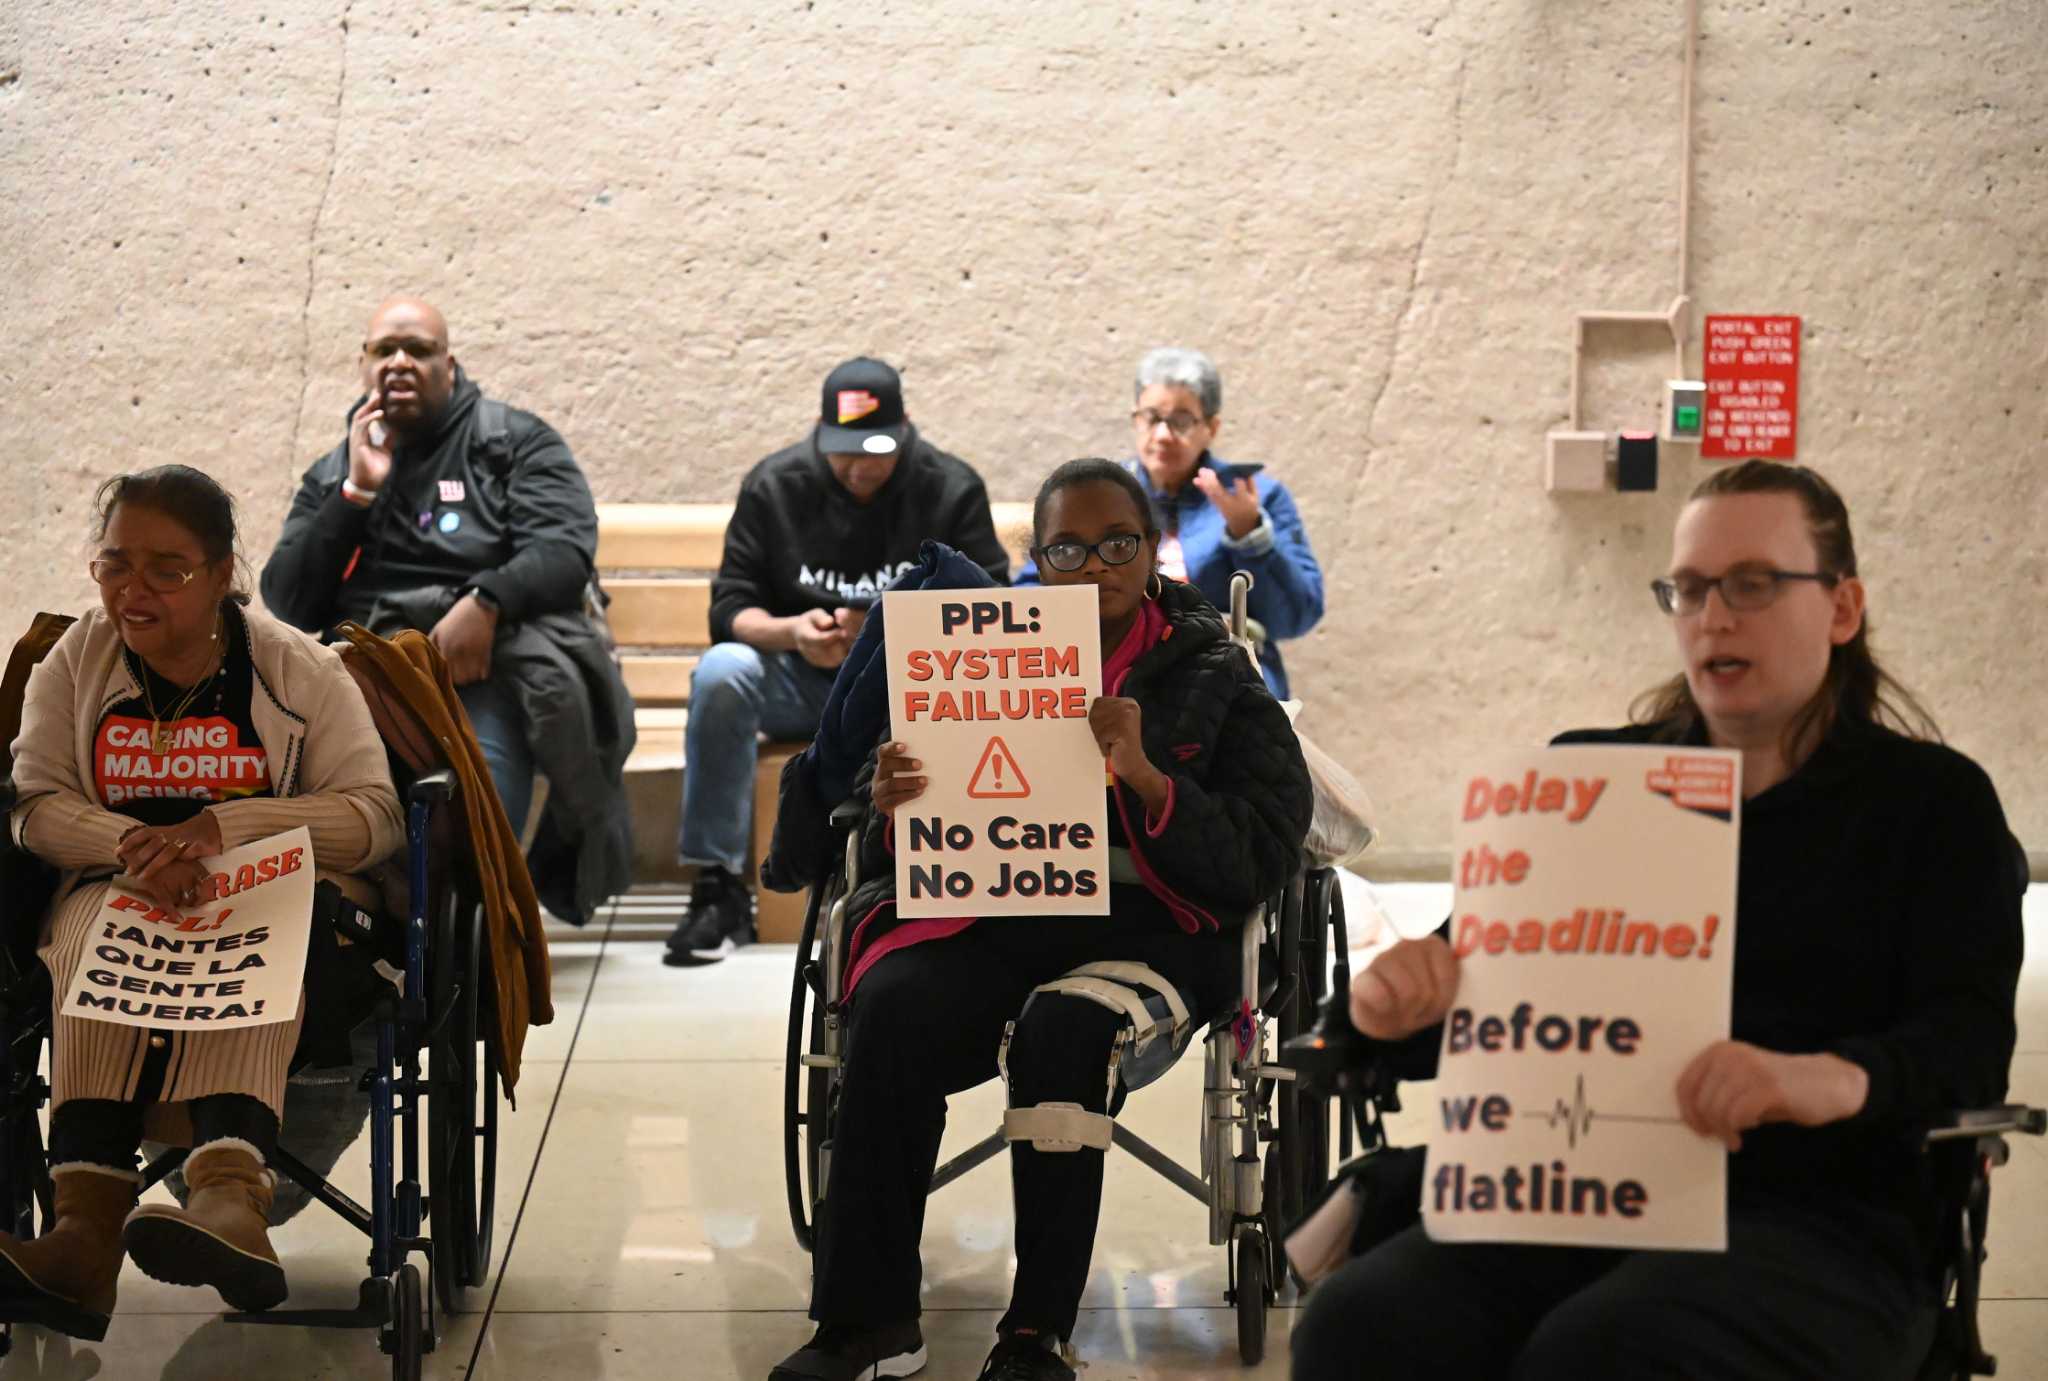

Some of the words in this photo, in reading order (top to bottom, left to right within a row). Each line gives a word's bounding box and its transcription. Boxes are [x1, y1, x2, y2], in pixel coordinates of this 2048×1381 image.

[1764, 321, 1793, 335] EXIT
[1708, 350, 1737, 364] EXIT
[1742, 350, 1793, 364] BUTTON
[941, 601, 1041, 635] PPL:
[907, 645, 1080, 681] SYSTEM
[904, 687, 1088, 721] FAILURE
[104, 754, 267, 779] MAJORITY
[1462, 770, 1606, 823] Delay
[909, 817, 974, 851] No
[987, 816, 1095, 850] Care
[206, 847, 304, 902] RASE
[909, 864, 974, 899] No
[987, 862, 1097, 898] Jobs
[1459, 844, 1531, 890] the
[102, 922, 270, 954] ¡ANTES
[1454, 910, 1719, 960] Deadline!
[95, 944, 196, 976] QUE
[208, 953, 267, 975] LA
[85, 969, 245, 997] GENTE
[76, 991, 266, 1021] MUERA!
[1447, 1002, 1643, 1055] Before
[1440, 1095, 1512, 1132] we
[1433, 1161, 1649, 1218] flatline
